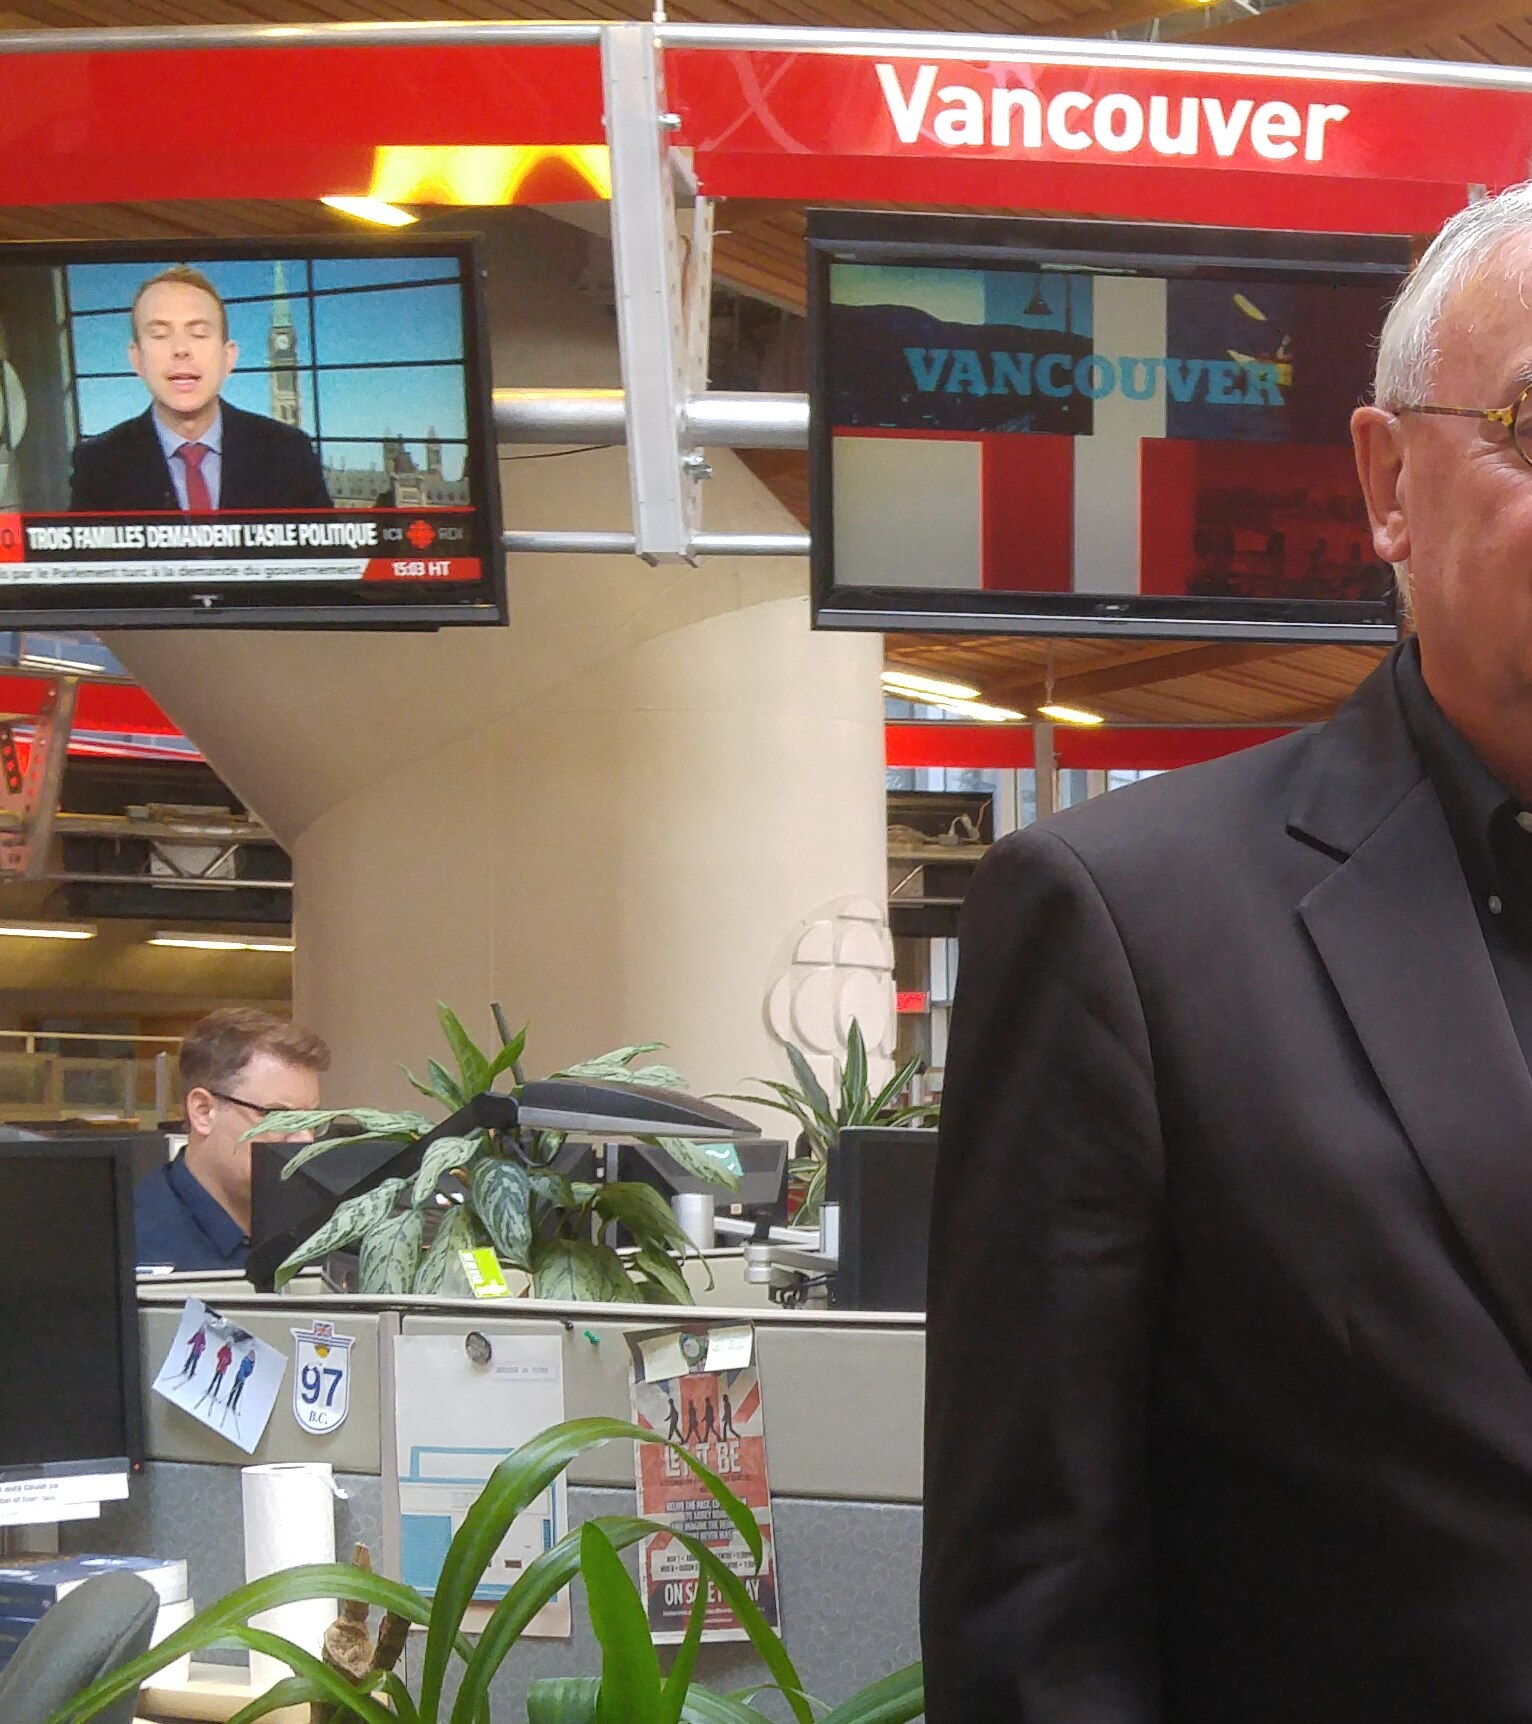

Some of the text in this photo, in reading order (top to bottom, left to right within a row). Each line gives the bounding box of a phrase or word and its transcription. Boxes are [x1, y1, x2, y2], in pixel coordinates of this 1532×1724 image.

[876, 63, 1350, 162] Vancouver
[905, 348, 1286, 406] VANCOUVER
[26, 526, 73, 550] TROIS
[74, 526, 146, 549] FAMILLES
[146, 524, 242, 548] DEMANDENT
[243, 523, 298, 547] L'ASILE
[299, 523, 379, 549] POLITIQUE
[53, 567, 116, 579] Parlement
[178, 566, 238, 577] demande
[264, 565, 362, 579] gouvernement
[391, 561, 451, 577] 15:03 HT
[301, 1364, 343, 1407] 97
[309, 1410, 328, 1425] B.C.
[716, 1441, 742, 1474] BE
[664, 1582, 683, 1606] ON
[685, 1580, 715, 1604] SE
